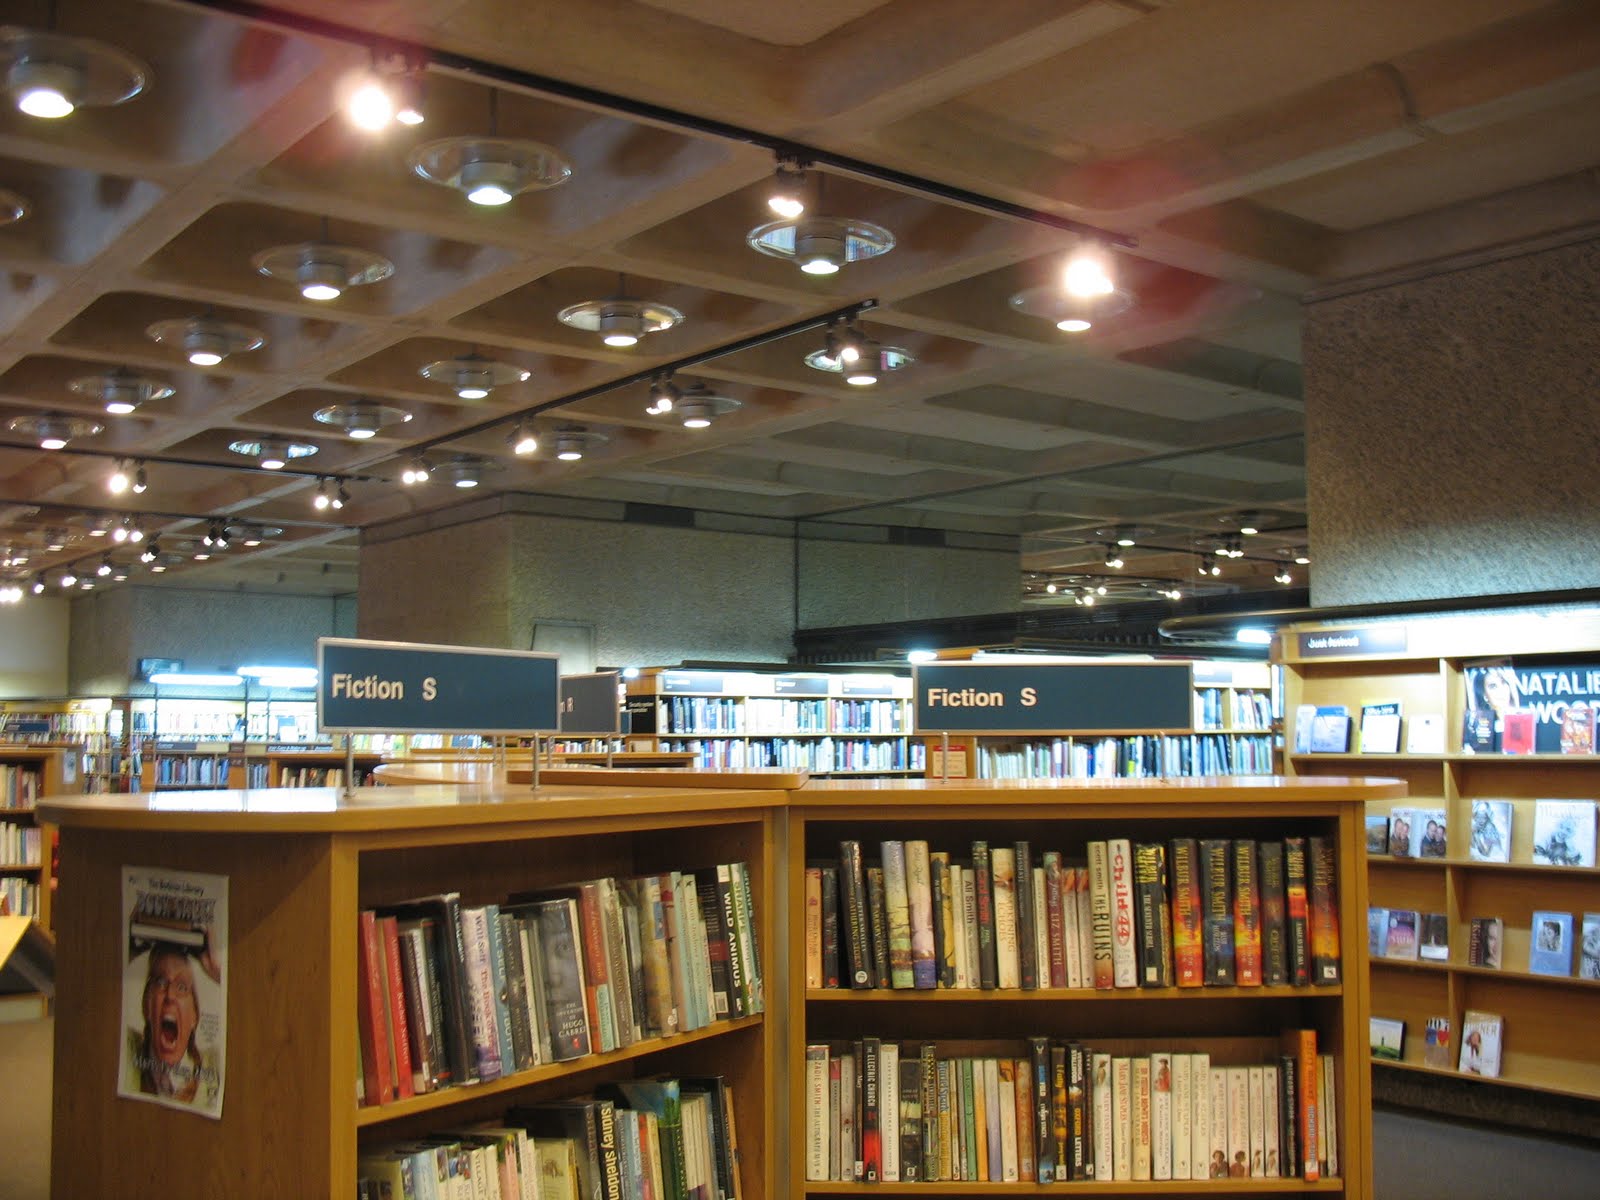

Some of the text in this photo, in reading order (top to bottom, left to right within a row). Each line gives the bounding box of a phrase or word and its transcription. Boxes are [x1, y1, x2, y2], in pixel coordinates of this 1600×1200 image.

[332, 673, 437, 701] Fiction S
[928, 687, 1037, 707] Fiction S
[1514, 671, 1600, 696] NATALIE
[1176, 846, 1189, 886] WILBUR
[1237, 846, 1251, 885] WILBUR
[964, 880, 974, 893] Ali
[1209, 848, 1227, 922] WILBUR SMITH
[965, 896, 976, 924] Smith
[1093, 845, 1112, 962] scott smith THE RUINS
[1178, 887, 1192, 917] SMITH
[1239, 887, 1253, 917] SMITH
[474, 915, 485, 940] Will
[492, 913, 502, 947] WILL
[849, 897, 859, 940] GATHERING
[1051, 913, 1061, 929] LIZ
[724, 892, 742, 988] WILD ANIMUS
[1052, 932, 1063, 966] SMITH
[496, 949, 505, 981] SELF
[562, 1020, 584, 1031] HUGO
[813, 1061, 823, 1082] ZADIE
[856, 1074, 864, 1089] Mary
[867, 1054, 876, 1083] ELECTRIC
[937, 1061, 949, 1089] Muriel
[1070, 1049, 1078, 1085] STALLWOOD
[1286, 1061, 1294, 1096] RICHARD
[813, 1083, 823, 1105] SMITH
[867, 1083, 876, 1107] CHURCH
[939, 1089, 950, 1114] Spark
[1120, 1097, 1128, 1122] STAPLES
[1074, 1107, 1082, 1167] OXFORD LETTERS
[601, 1107, 622, 1200] sidney sheldon
[474, 1154, 484, 1195] VILLAGE
